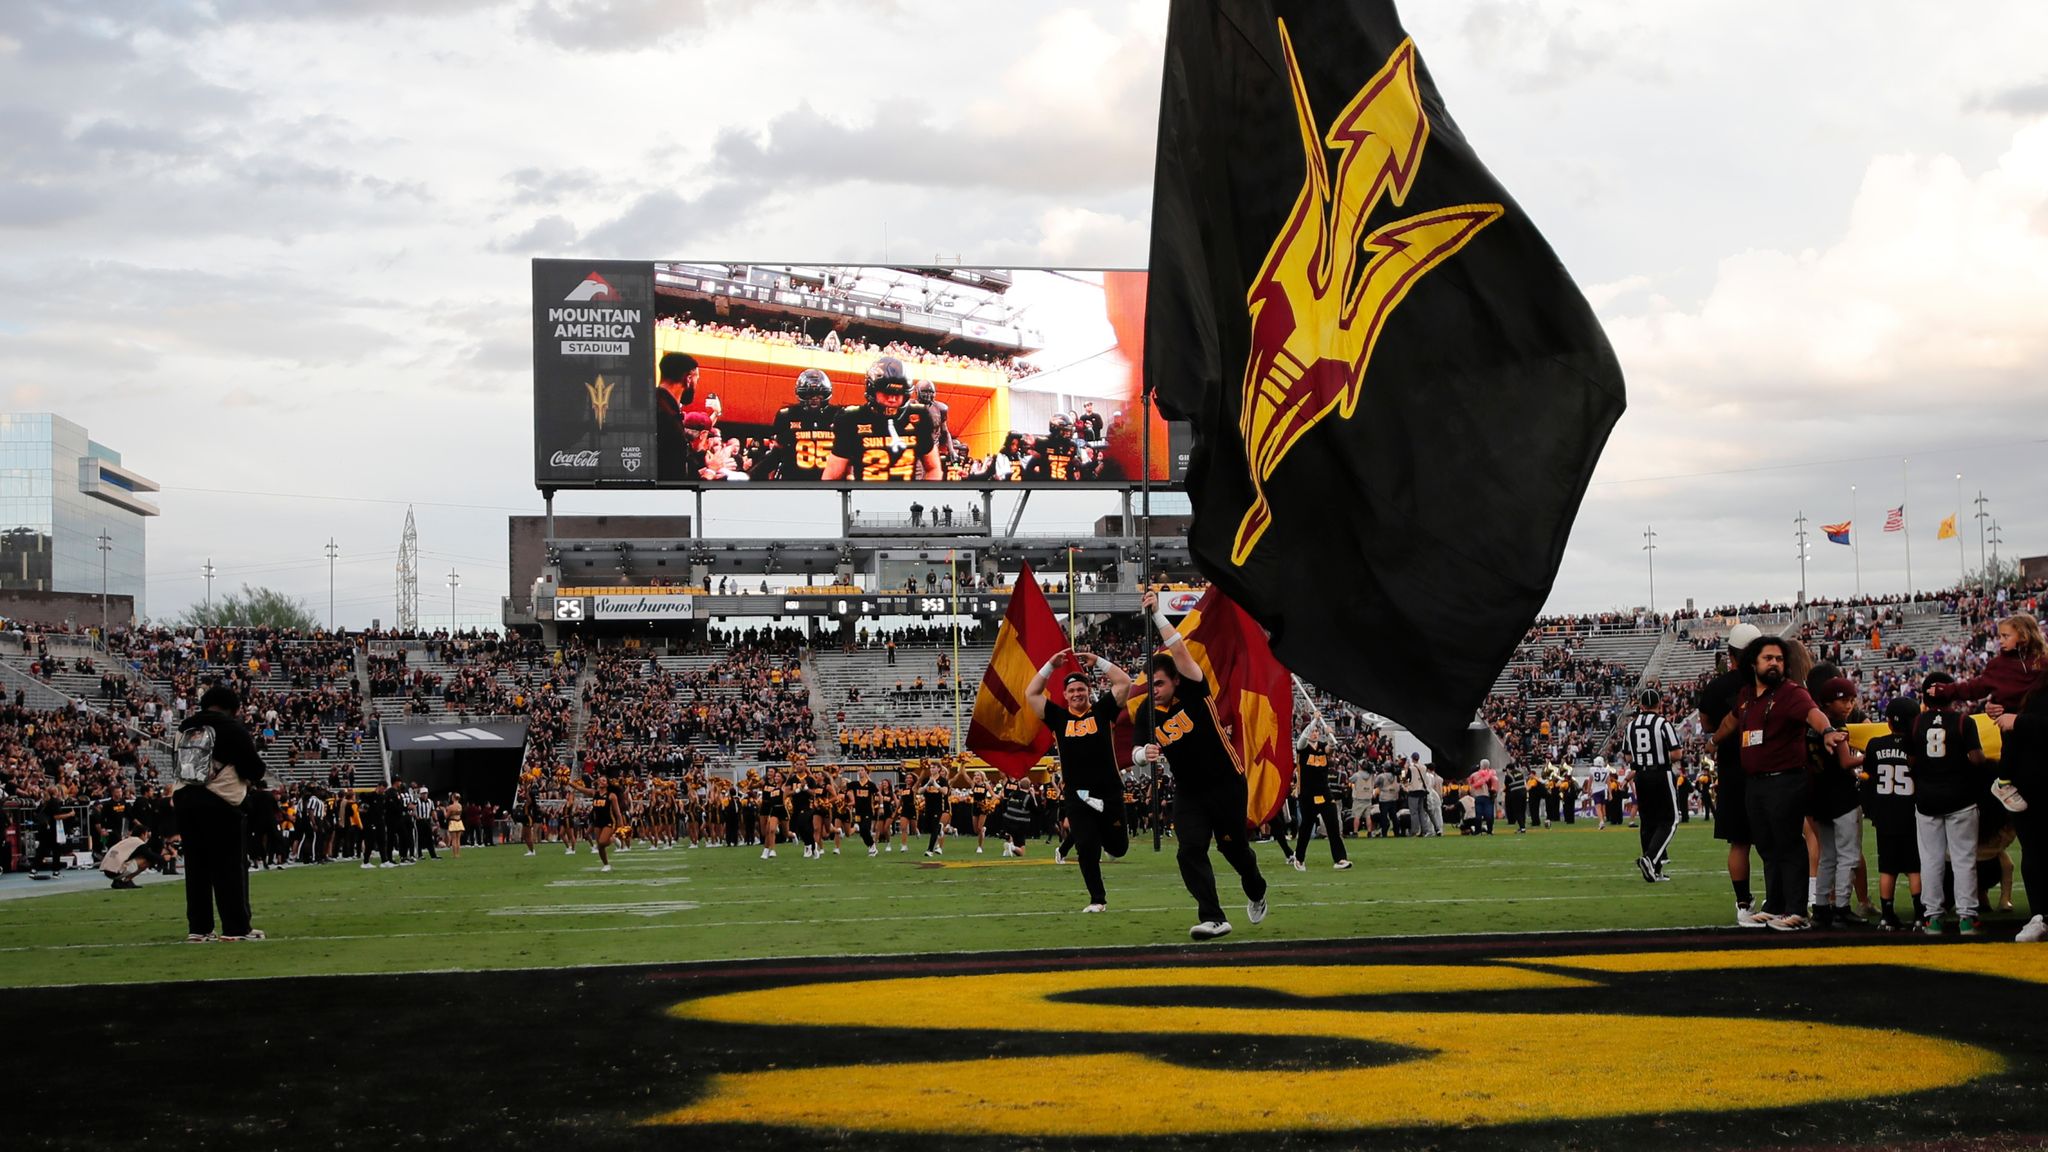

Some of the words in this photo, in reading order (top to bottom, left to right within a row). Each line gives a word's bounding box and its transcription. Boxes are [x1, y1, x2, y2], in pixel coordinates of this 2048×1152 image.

[548, 308, 640, 322] MOUNTAIN
[554, 324, 635, 338] AMERICA
[569, 343, 622, 353] STADIUM
[795, 431, 811, 440] SUN
[863, 437, 887, 448] SUN
[550, 450, 601, 467] Coca-Cola
[861, 449, 915, 480] 24
[557, 600, 581, 618] 25
[596, 597, 691, 613] Someburros
[838, 600, 847, 614] 0
[1065, 716, 1098, 737] ASU
[1635, 728, 1651, 752] B
[1926, 728, 1946, 757] 8
[1593, 772, 1607, 782] 97
[1876, 764, 1915, 796] 35
